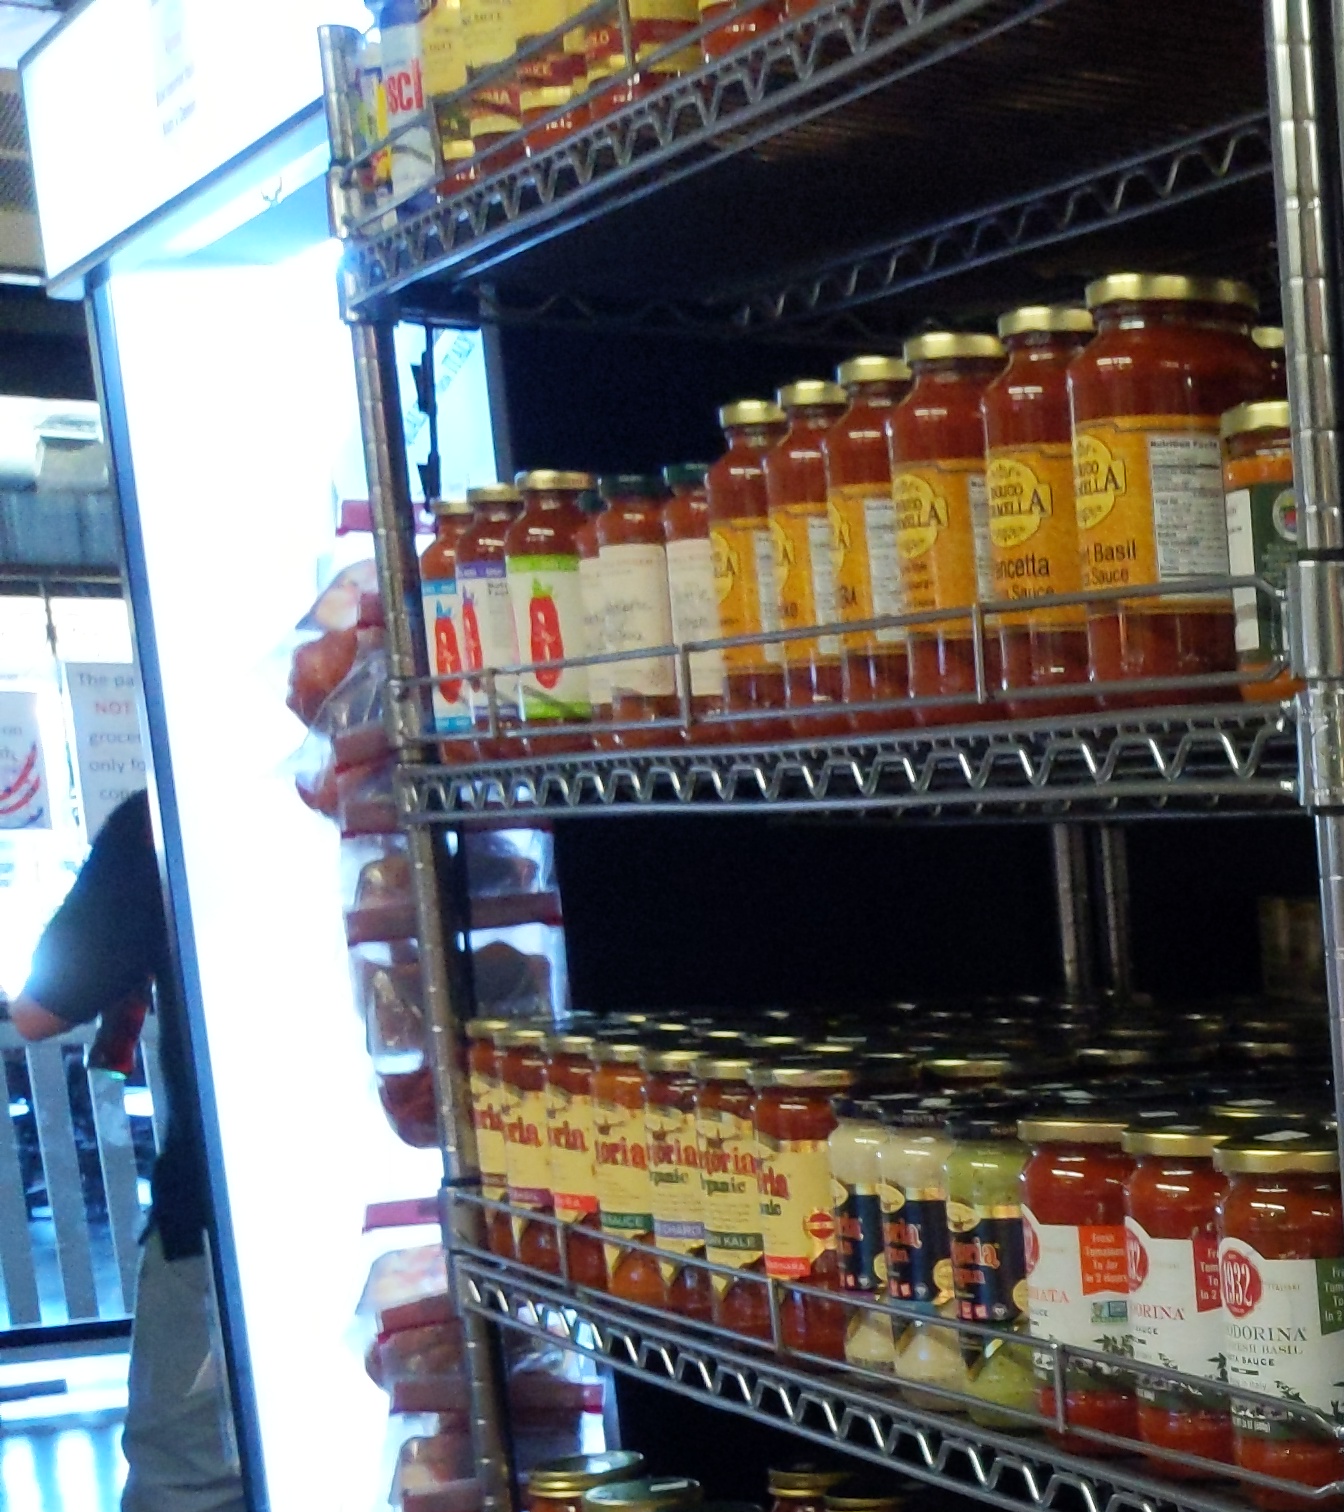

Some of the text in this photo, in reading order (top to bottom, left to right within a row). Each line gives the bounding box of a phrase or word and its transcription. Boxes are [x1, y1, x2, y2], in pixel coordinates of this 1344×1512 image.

[1094, 541, 1136, 562] Basil
[1092, 567, 1128, 582] Sauce
[95, 702, 130, 714] NOT
[89, 760, 125, 772] only
[1223, 1261, 1252, 1307] 1932
[1242, 1357, 1275, 1366] SAUCE
